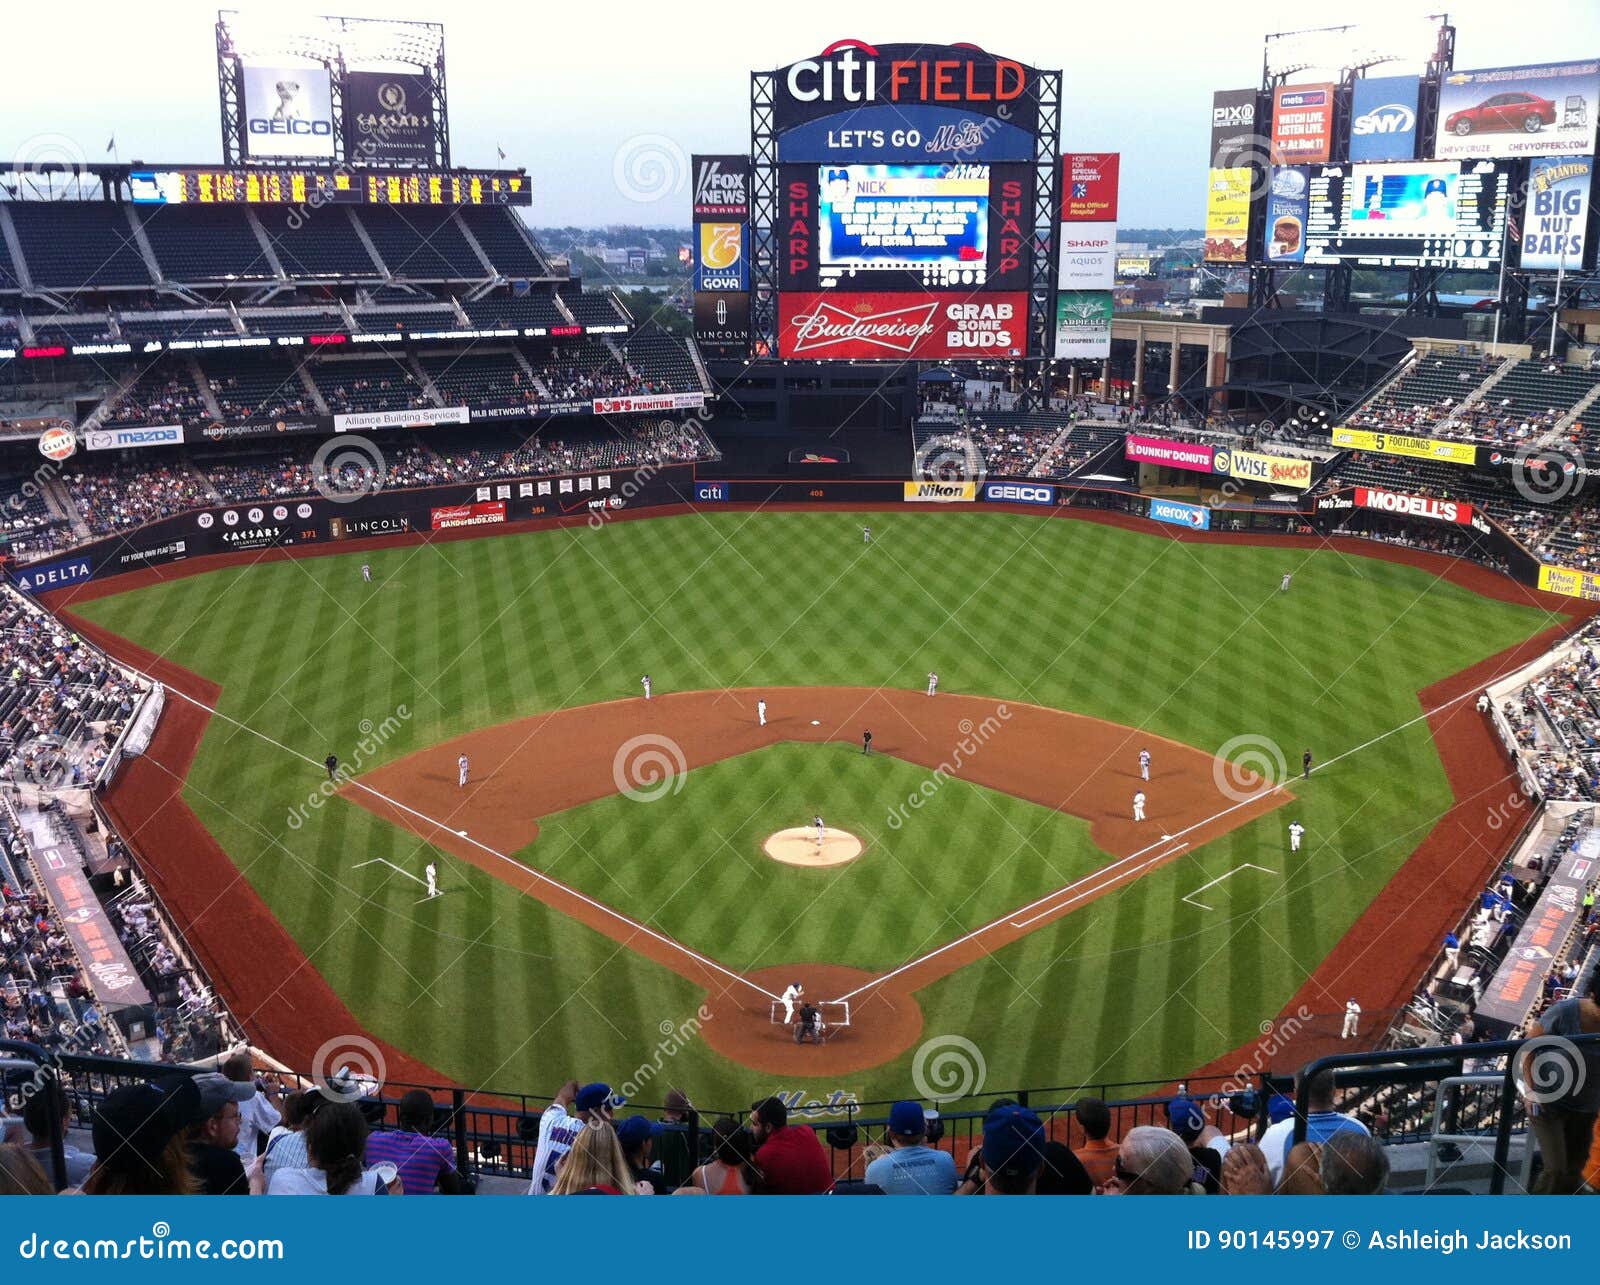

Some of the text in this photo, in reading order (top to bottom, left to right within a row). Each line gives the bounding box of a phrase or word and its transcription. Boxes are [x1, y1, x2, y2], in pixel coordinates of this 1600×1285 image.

[891, 61, 1026, 101] FIELD
[357, 113, 429, 128] CAESARS
[1279, 113, 1305, 124] WATCH
[1353, 113, 1406, 135] SNY
[250, 119, 331, 135] GEICO
[1278, 125, 1304, 135] LISTEN
[828, 122, 983, 152] LET'S GO Mets
[1508, 140, 1588, 152] CHEVYOFFERS.COM
[1547, 164, 1588, 180] PLANTERS
[711, 174, 745, 189] FOX
[857, 181, 886, 194] NICK
[702, 190, 746, 204] NEWS
[1535, 189, 1582, 216] BIG
[789, 182, 809, 275] SHARP
[1000, 181, 1022, 274] SHARP
[1541, 217, 1573, 232] NUT
[1488, 240, 1500, 257] 2
[1525, 234, 1581, 255] BARS
[1071, 257, 1103, 265] AQUOS
[703, 278, 739, 289] GOYA
[946, 303, 1013, 320] GRAB
[792, 314, 933, 338] Budweiser
[957, 320, 1001, 330] SOME
[696, 331, 749, 339] LINCOLN
[946, 331, 1012, 347] BUDS
[472, 407, 526, 418] MLB NETWORK
[594, 400, 673, 412] BOB'S FURNITURE
[345, 410, 460, 425] Alliance Building Services
[42, 436, 71, 452] Gulf
[118, 430, 177, 444] mazda
[1372, 434, 1385, 450] $5
[1389, 438, 1430, 450] FOOTLONGS
[1136, 445, 1210, 465] DUNKIN' DONUTS
[1502, 456, 1525, 465] pepsi
[1234, 455, 1309, 480] WISE SNACKS
[700, 487, 721, 499] citi
[917, 484, 964, 497] Nikon
[987, 486, 1050, 501] GEICO
[276, 508, 285, 517] 42
[1155, 504, 1190, 521] xerox
[1366, 491, 1457, 522] MODELL'S
[201, 517, 211, 525] 37
[346, 518, 408, 533] LINCOLN
[223, 527, 280, 541] CAESARS
[302, 530, 317, 539] 371
[121, 555, 130, 563] FLY
[131, 551, 143, 560] YOUR
[157, 547, 169, 556] FLAG
[36, 564, 89, 586] DELTA
[778, 1090, 860, 1118] Mets
